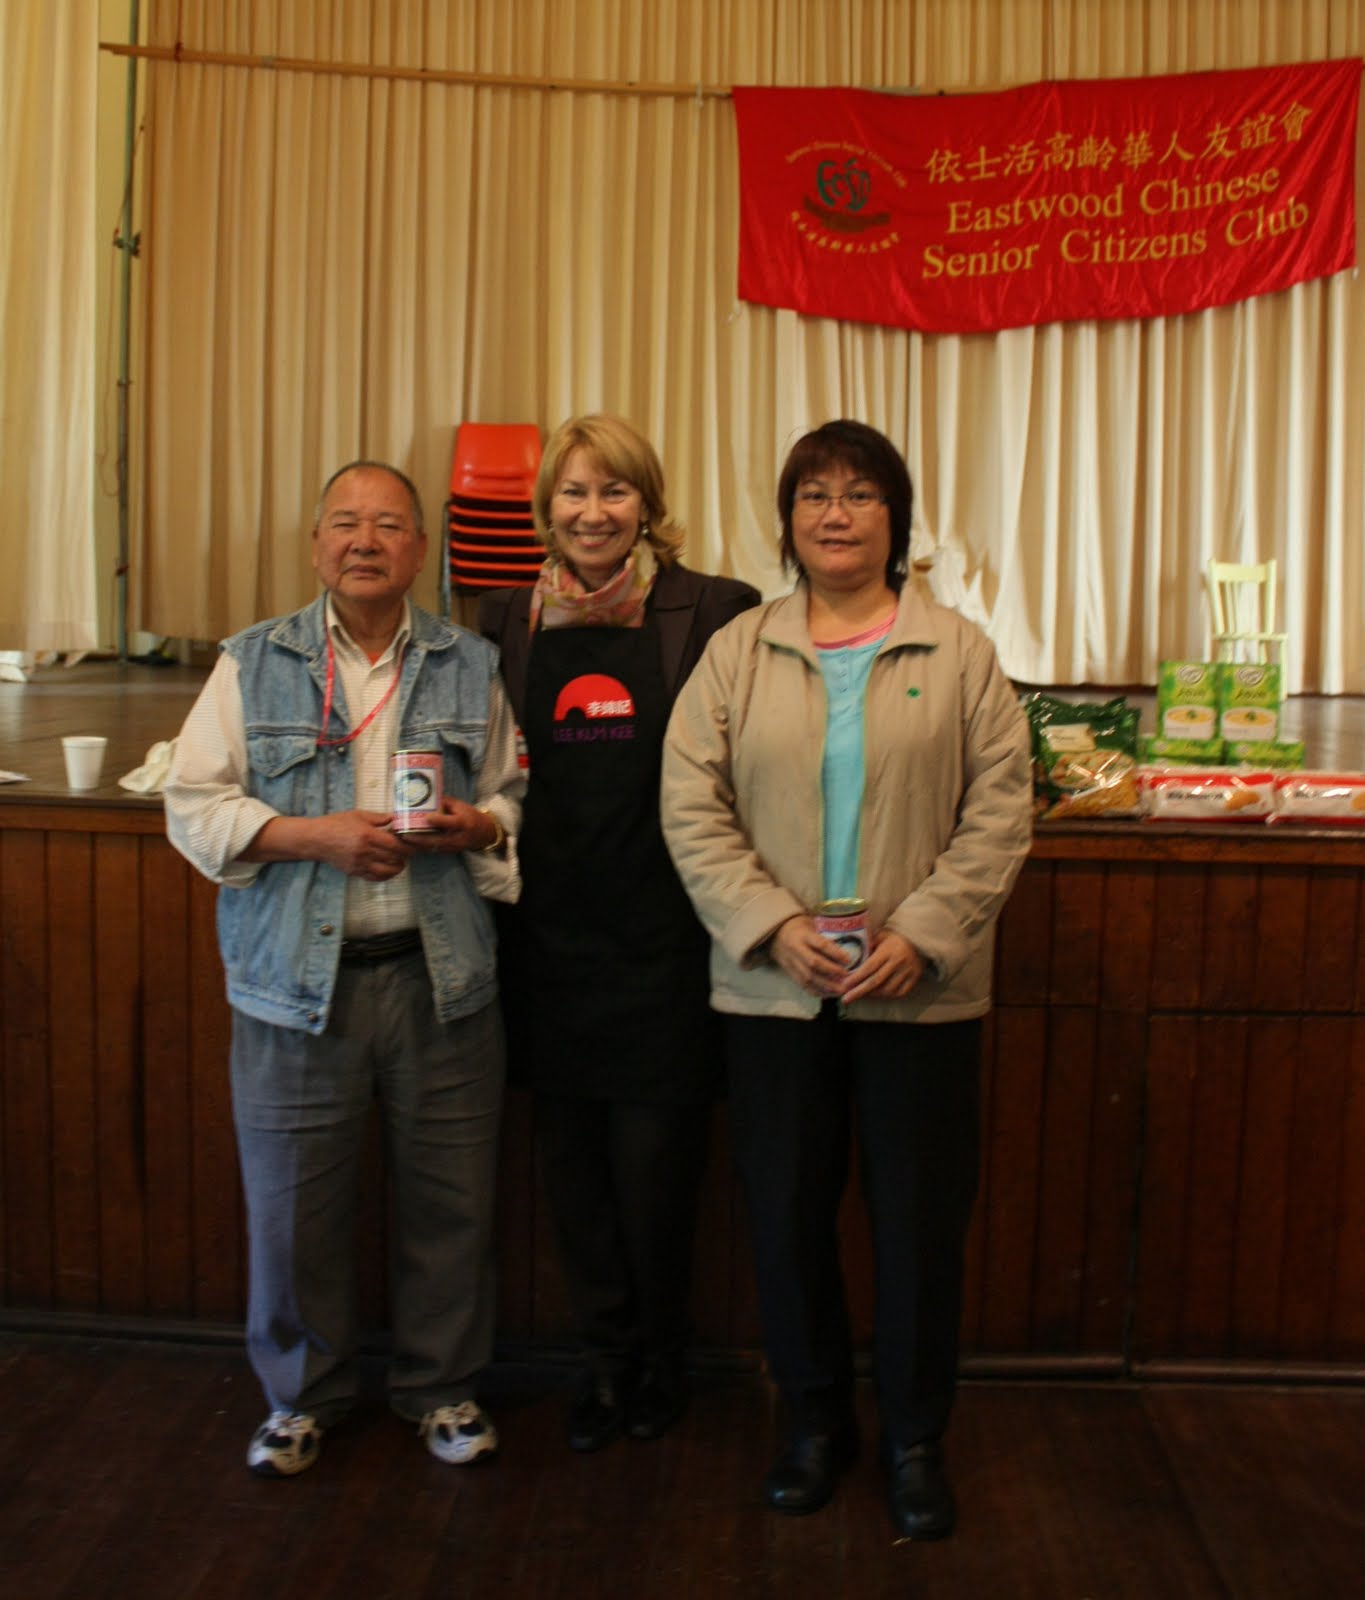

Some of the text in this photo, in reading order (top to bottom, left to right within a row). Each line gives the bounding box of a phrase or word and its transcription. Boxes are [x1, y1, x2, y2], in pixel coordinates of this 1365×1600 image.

[924, 102, 1312, 184] 依士活高齡華人友誼會
[922, 196, 1309, 279] Senior Citizens Club
[946, 183, 1124, 234] Eastwood
[1140, 167, 1280, 215] Chinese
